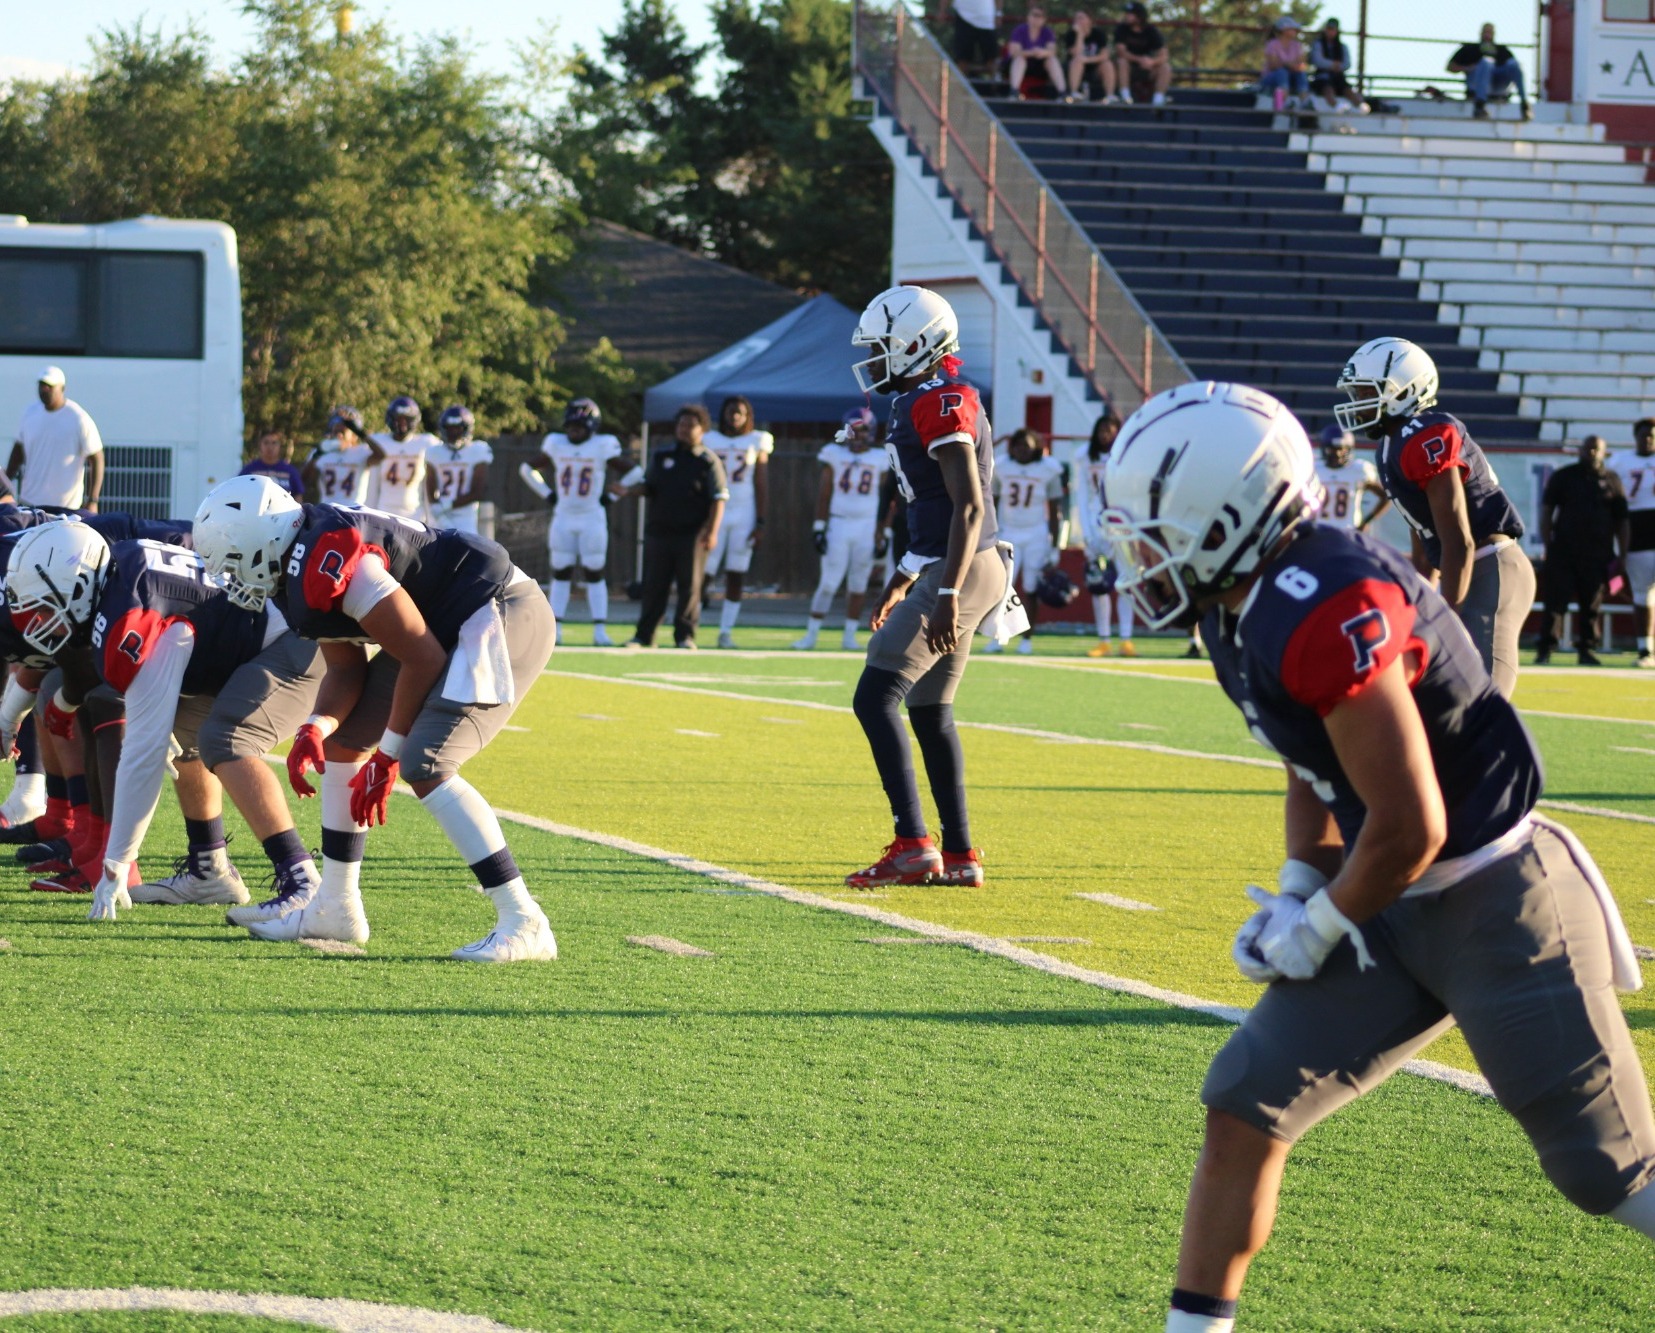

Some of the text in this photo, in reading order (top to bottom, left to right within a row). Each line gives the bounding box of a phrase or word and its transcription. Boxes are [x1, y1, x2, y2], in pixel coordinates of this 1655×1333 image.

[918, 378, 945, 391] 13
[940, 393, 963, 417] P
[1400, 418, 1424, 439] 41
[1422, 436, 1446, 464] P
[324, 470, 357, 498] 24
[385, 461, 417, 486] 47
[440, 470, 466, 497] 21
[561, 465, 593, 497] 46
[839, 466, 873, 496] 48
[1630, 470, 1655, 498] 7
[1008, 483, 1034, 508] 31
[1320, 486, 1348, 519] 28
[318, 549, 344, 586] P
[1274, 565, 1319, 601] 6
[118, 629, 143, 664] P
[1340, 608, 1391, 674] P
